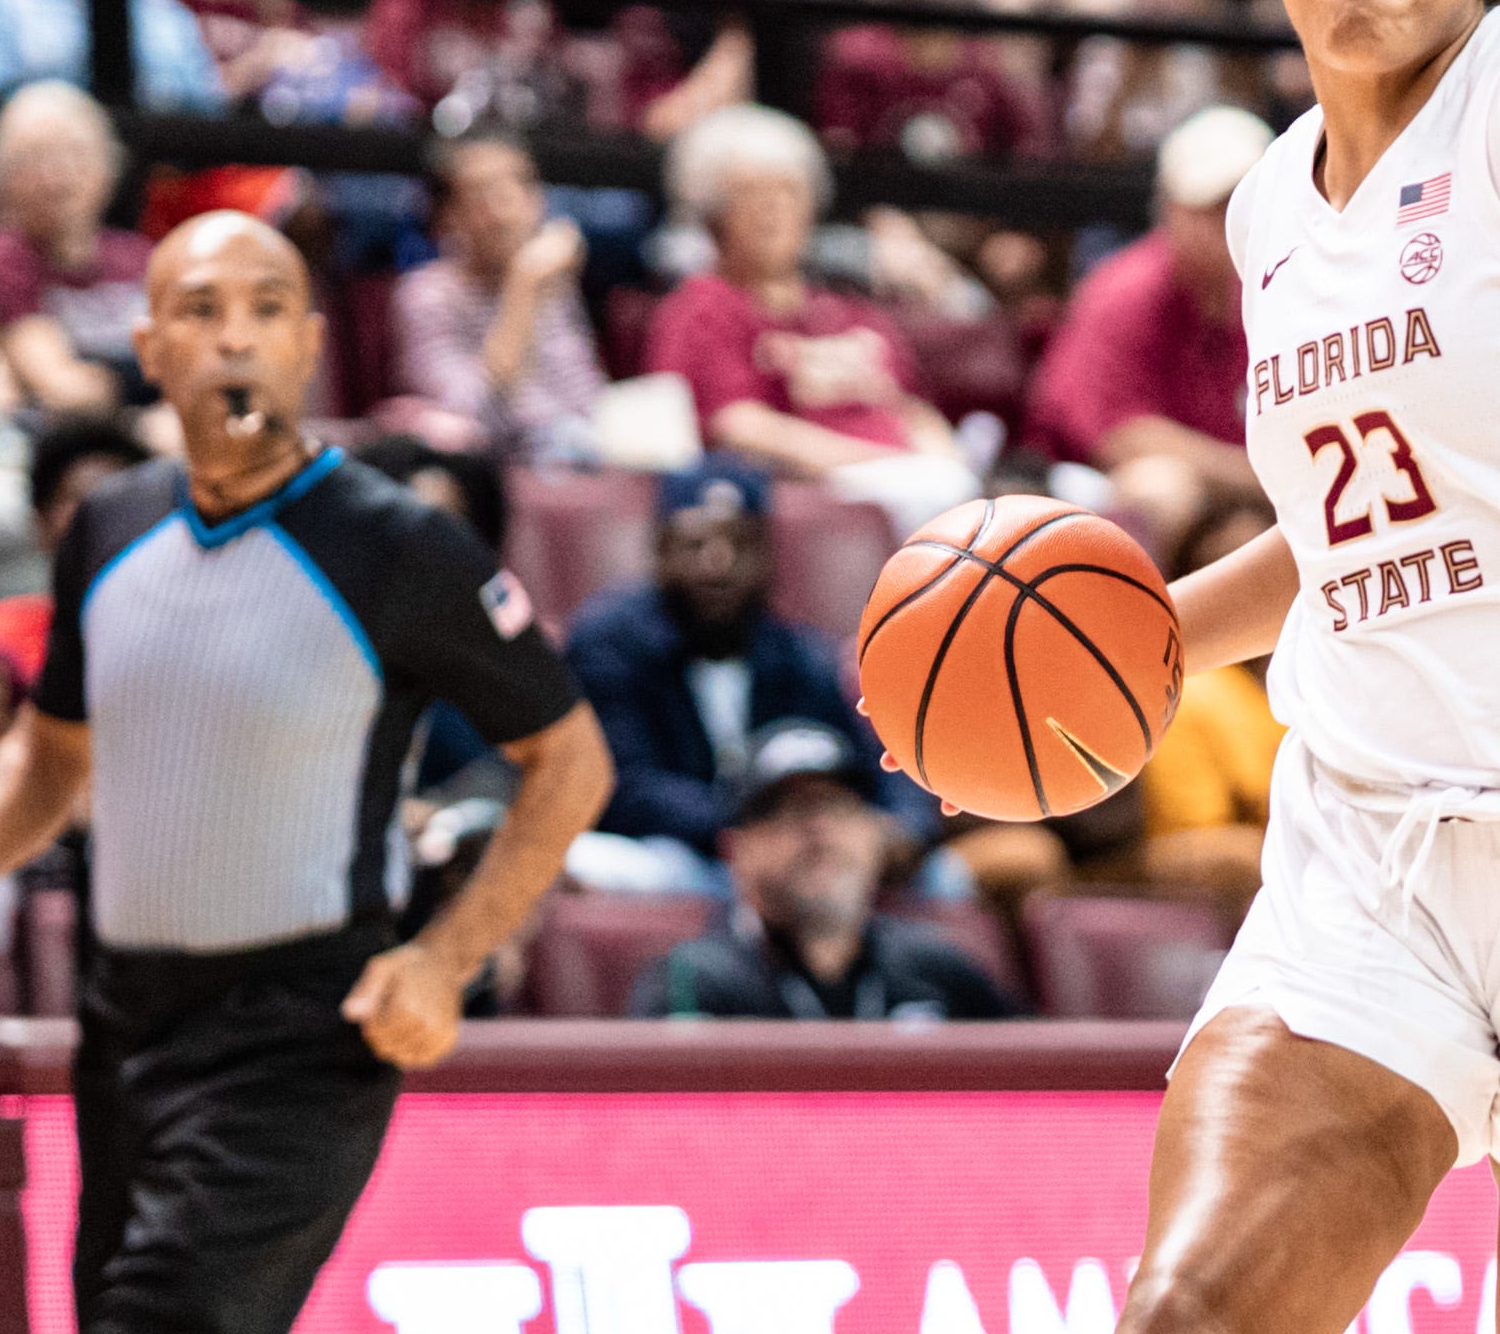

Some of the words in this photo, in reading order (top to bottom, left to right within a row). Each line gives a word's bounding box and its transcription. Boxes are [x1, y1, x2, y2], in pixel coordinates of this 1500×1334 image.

[1253, 307, 1442, 417] FLORIDA
[1303, 408, 1440, 551] 23
[1320, 539, 1484, 633] STATE
